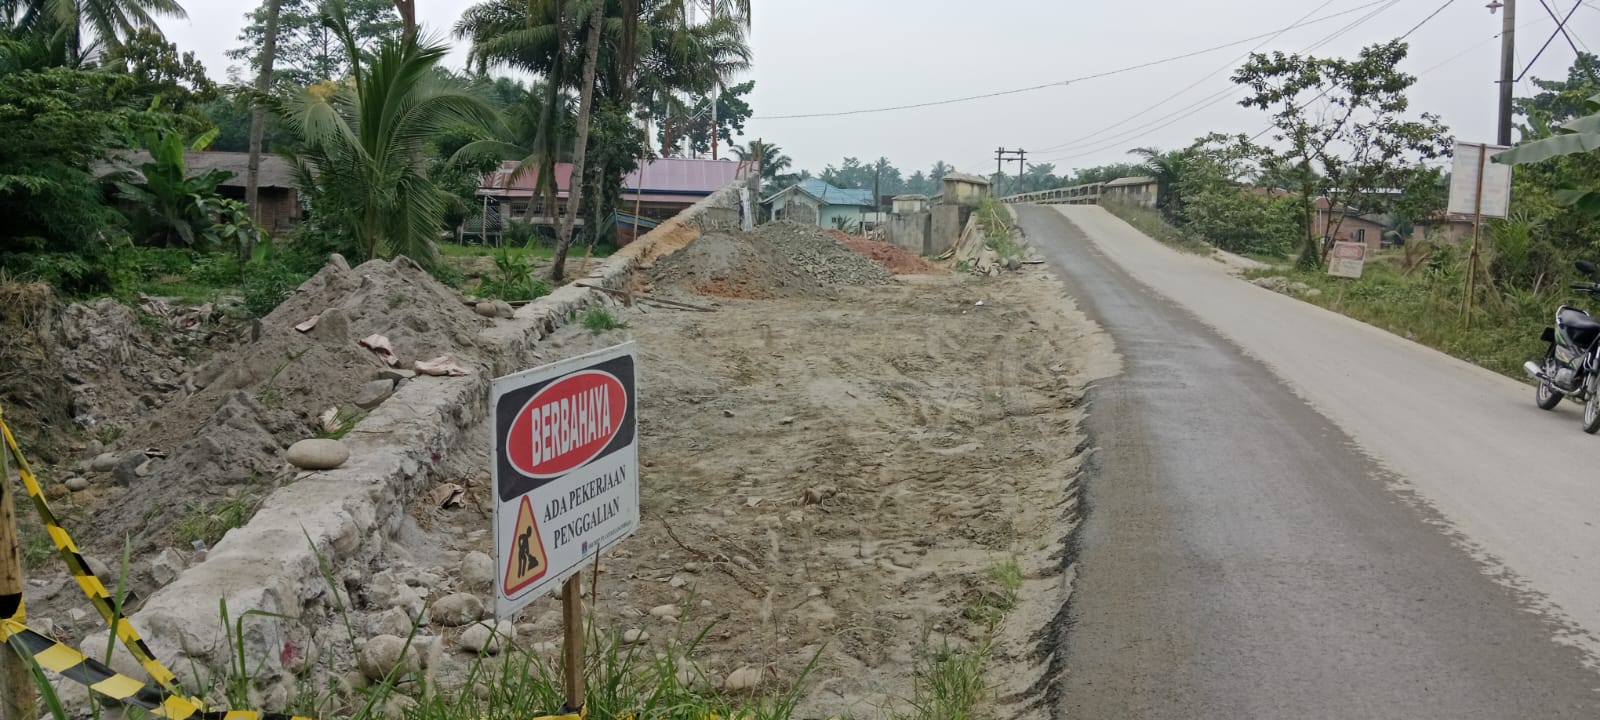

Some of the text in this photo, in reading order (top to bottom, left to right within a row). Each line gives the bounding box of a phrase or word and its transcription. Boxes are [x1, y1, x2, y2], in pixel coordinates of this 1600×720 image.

[531, 383, 611, 467] BERBAHAYA
[543, 464, 626, 523] ADA PEKERJAAN
[553, 496, 620, 549] PENGGALIAN
